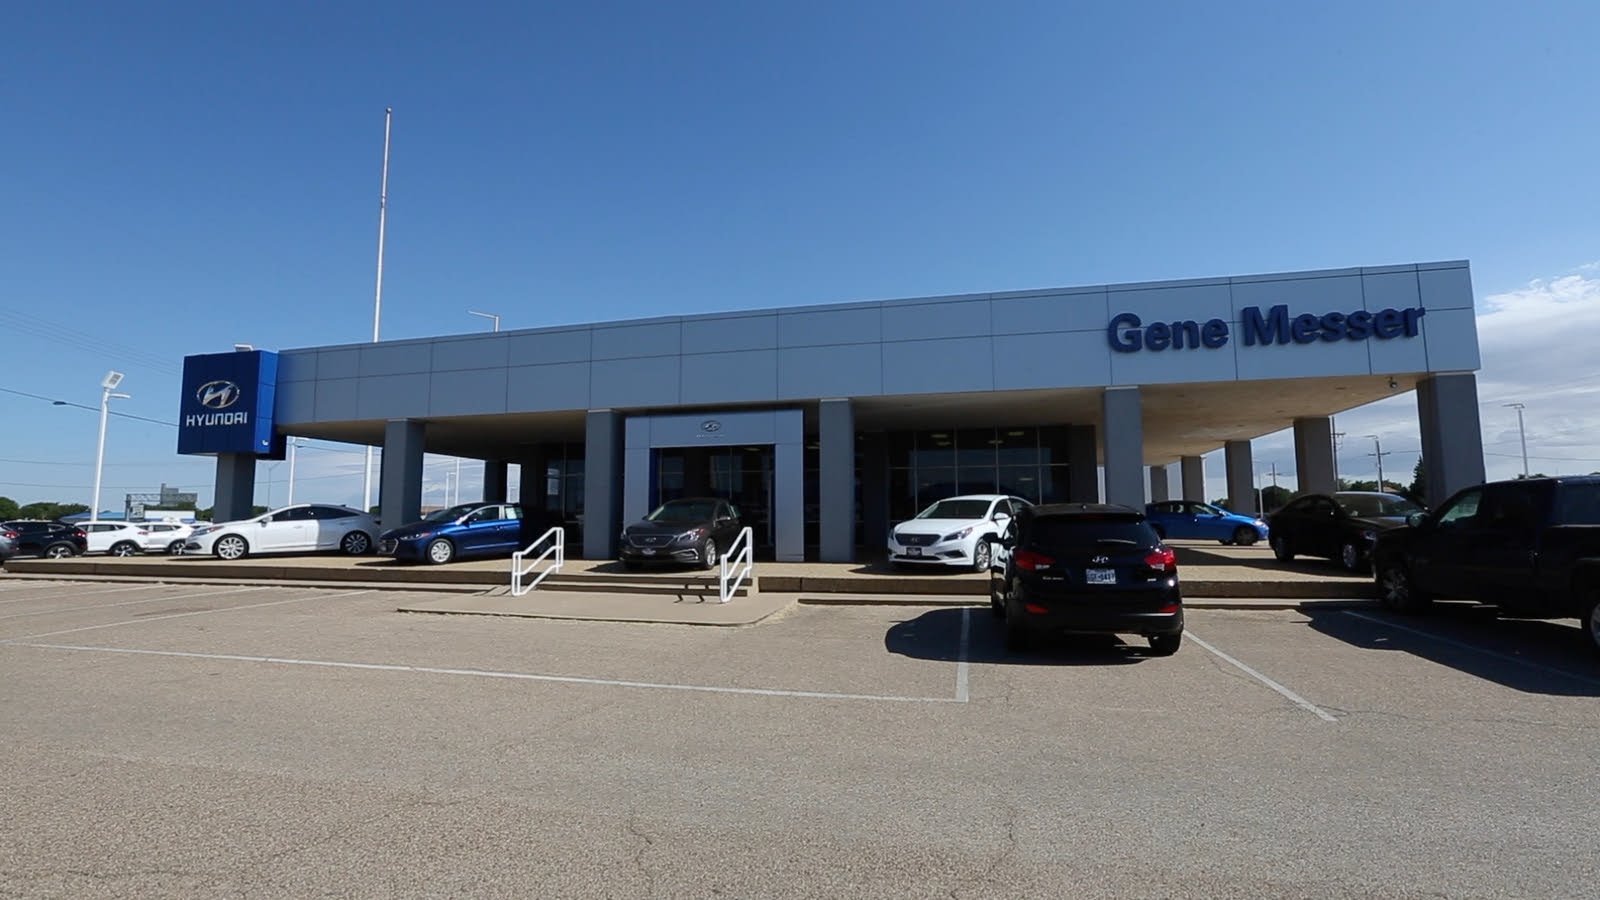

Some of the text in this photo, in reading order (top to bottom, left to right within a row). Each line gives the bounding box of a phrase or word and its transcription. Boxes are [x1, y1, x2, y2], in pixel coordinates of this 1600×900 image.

[1107, 304, 1426, 351] Gene Messer
[186, 411, 248, 427] HYUNDAI
